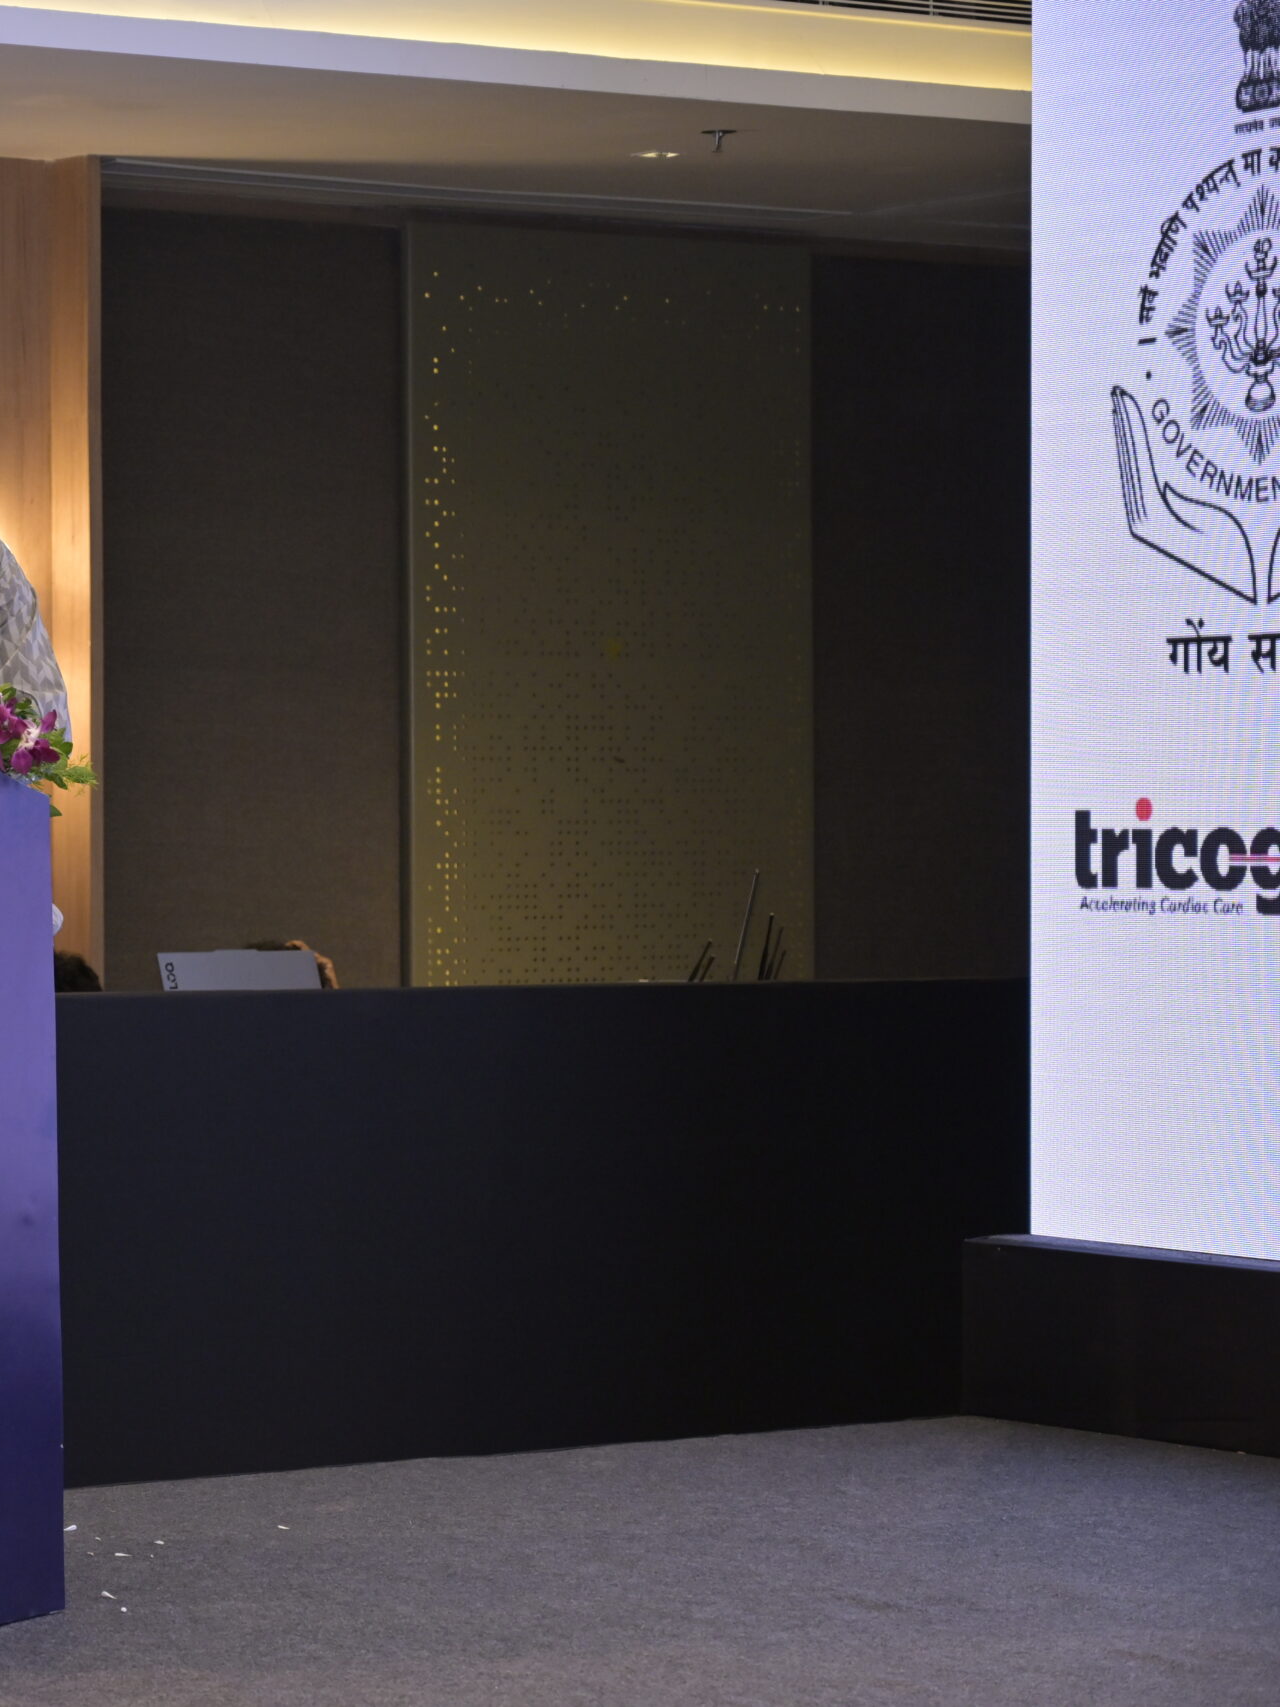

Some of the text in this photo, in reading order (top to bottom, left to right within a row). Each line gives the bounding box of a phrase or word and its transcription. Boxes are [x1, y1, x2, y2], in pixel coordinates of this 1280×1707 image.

[1241, 148, 1263, 176] मा
[1166, 618, 1232, 674] गोंय
[1079, 896, 1244, 915] Accelerating Cardiac Care
[165, 962, 178, 990] LOQ
